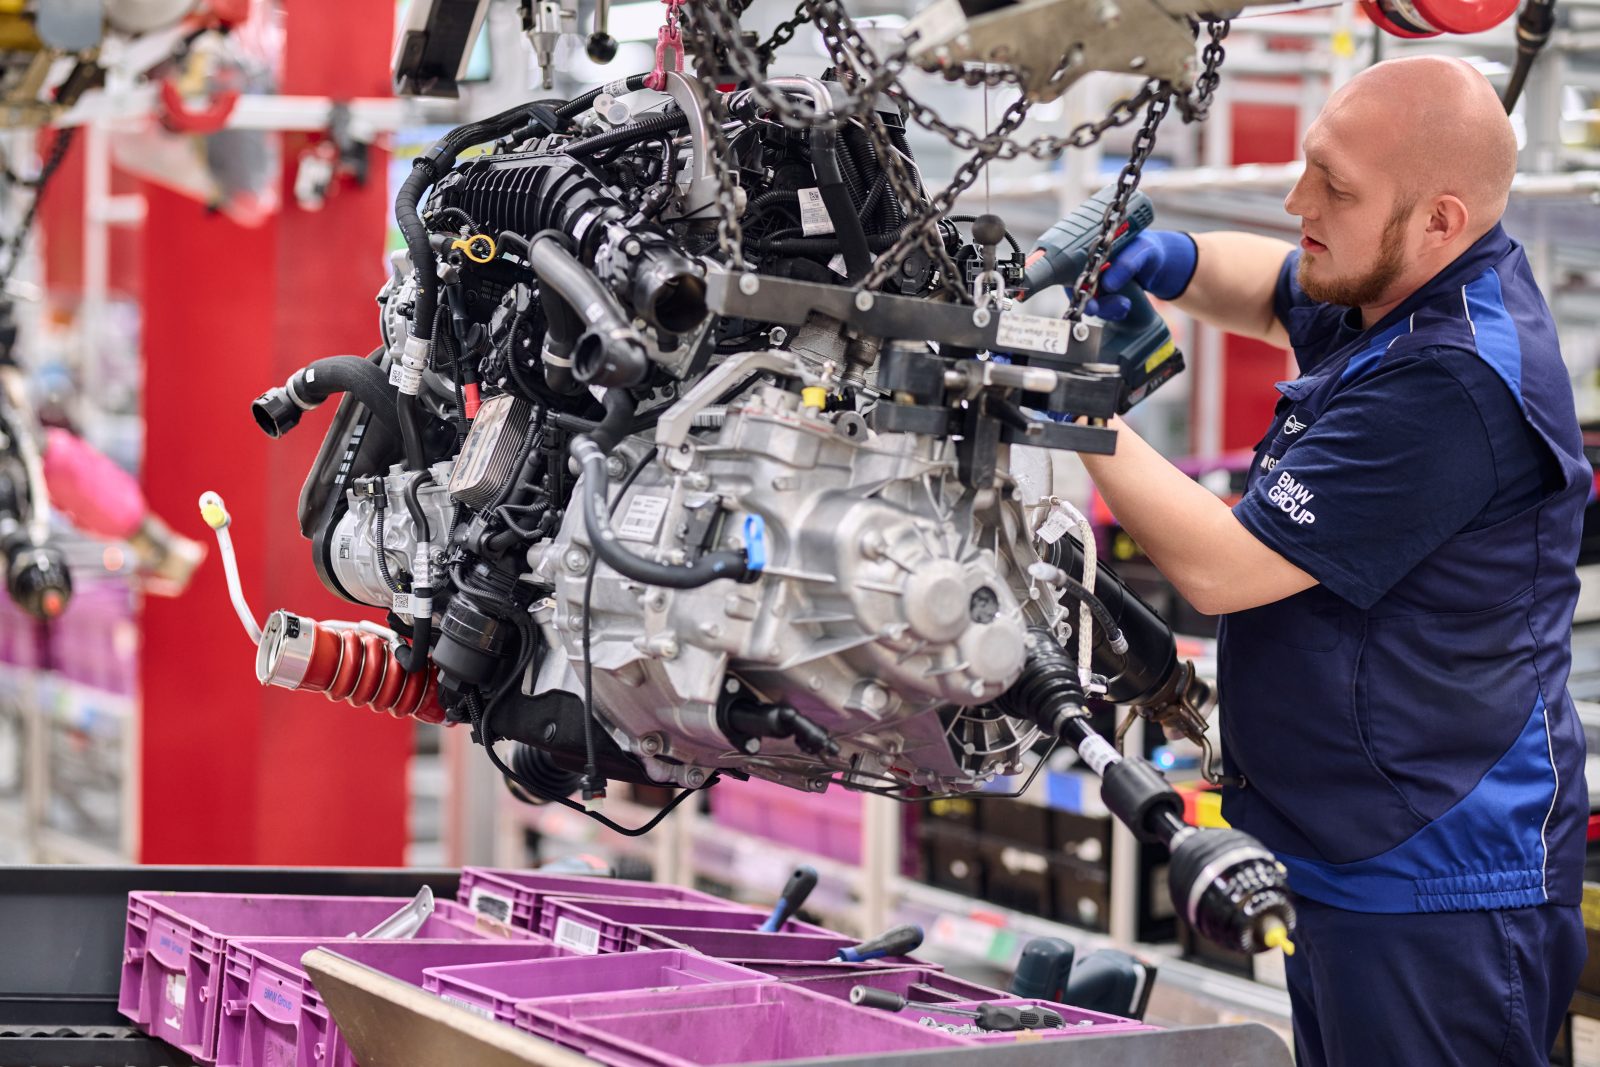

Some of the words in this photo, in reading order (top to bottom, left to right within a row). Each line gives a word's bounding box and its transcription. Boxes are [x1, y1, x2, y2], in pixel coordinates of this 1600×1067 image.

[1268, 485, 1315, 525] GROUP
[1277, 471, 1314, 505] BMW
[263, 987, 277, 1002] BMW
[277, 994, 292, 1012] Group
